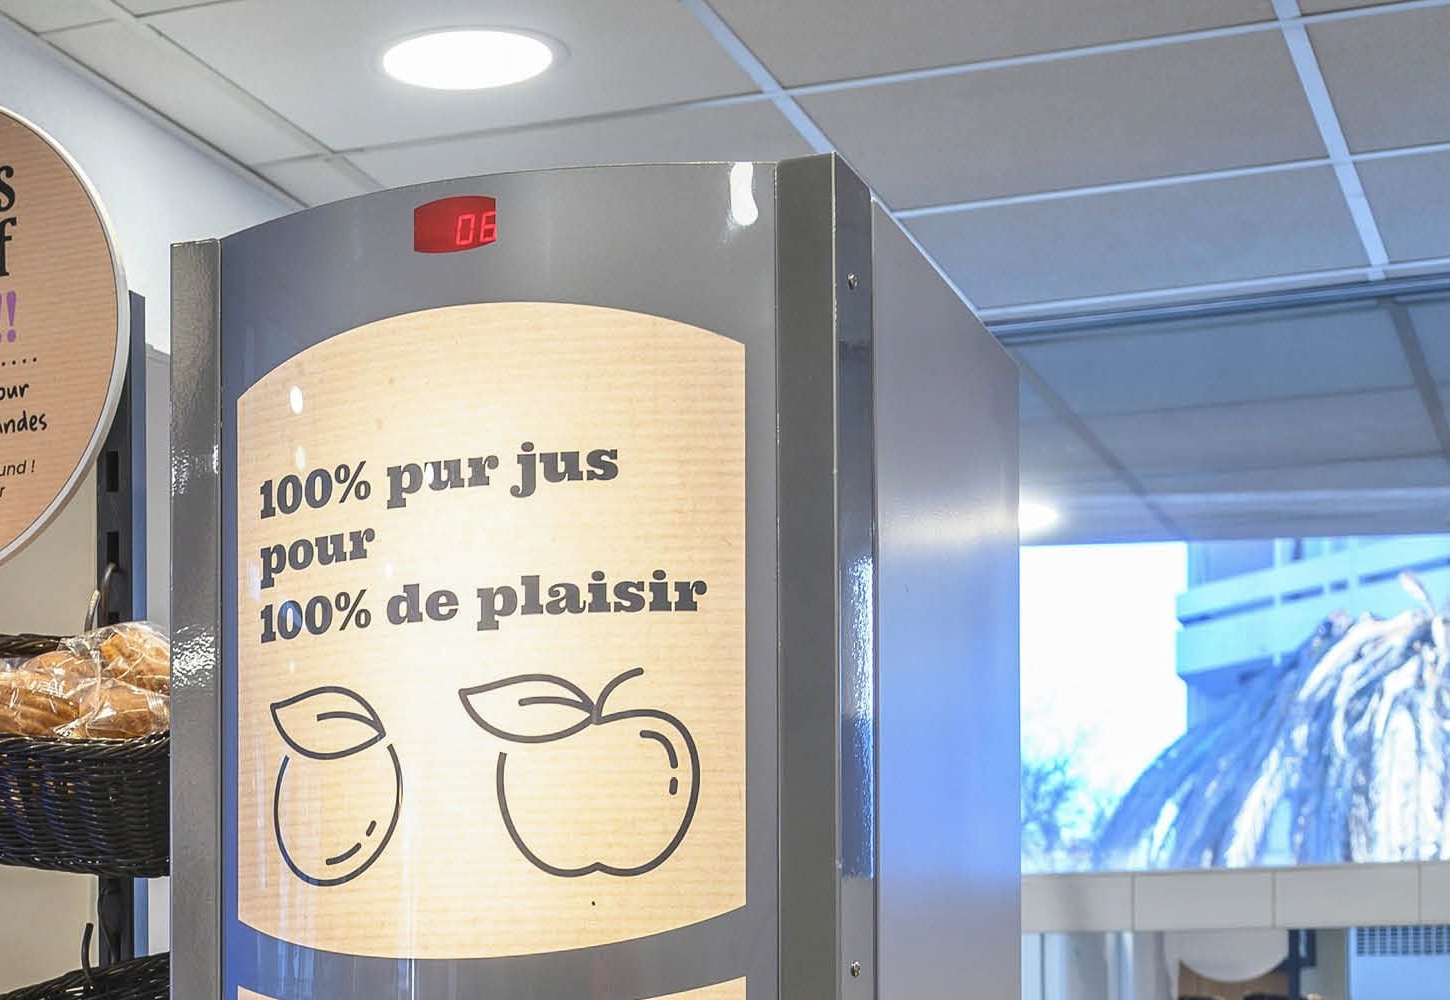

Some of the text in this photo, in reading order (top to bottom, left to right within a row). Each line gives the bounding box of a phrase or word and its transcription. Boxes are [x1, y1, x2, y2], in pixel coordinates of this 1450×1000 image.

[260, 441, 619, 519] 100% pur jus
[260, 527, 375, 589] pour
[261, 569, 708, 643] 100% de plaisir
